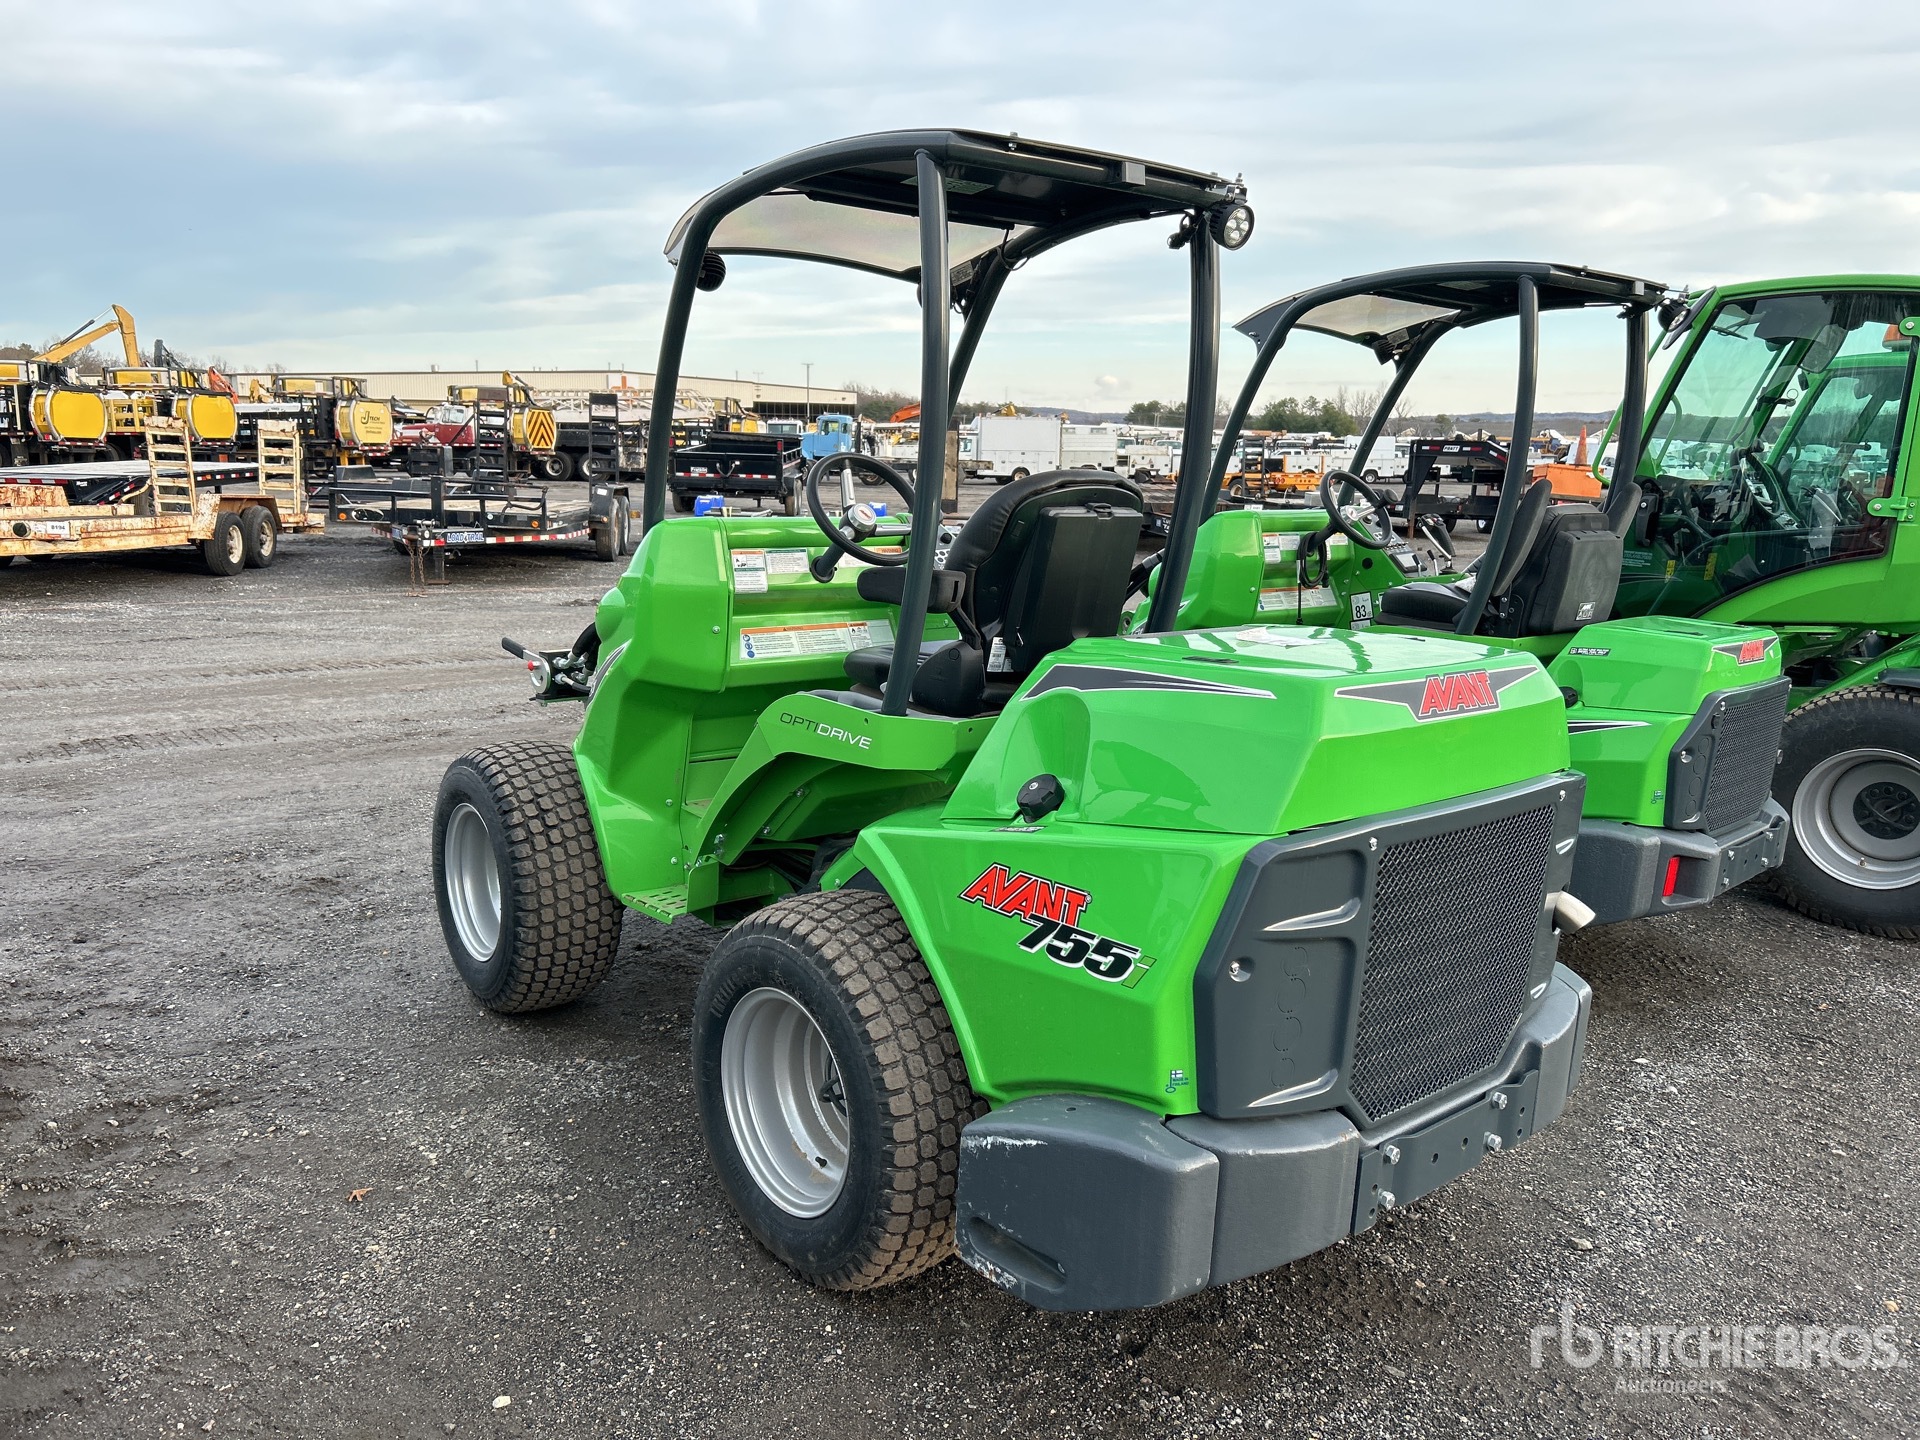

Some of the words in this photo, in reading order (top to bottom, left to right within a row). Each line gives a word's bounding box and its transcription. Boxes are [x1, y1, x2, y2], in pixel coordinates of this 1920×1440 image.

[446, 532, 464, 542] LOAD
[467, 532, 484, 541] TRAIL
[1355, 605, 1366, 618] 83
[1418, 670, 1496, 716] AVANT
[780, 712, 873, 749] OPTIDRIVE
[958, 862, 1089, 928] AVANT
